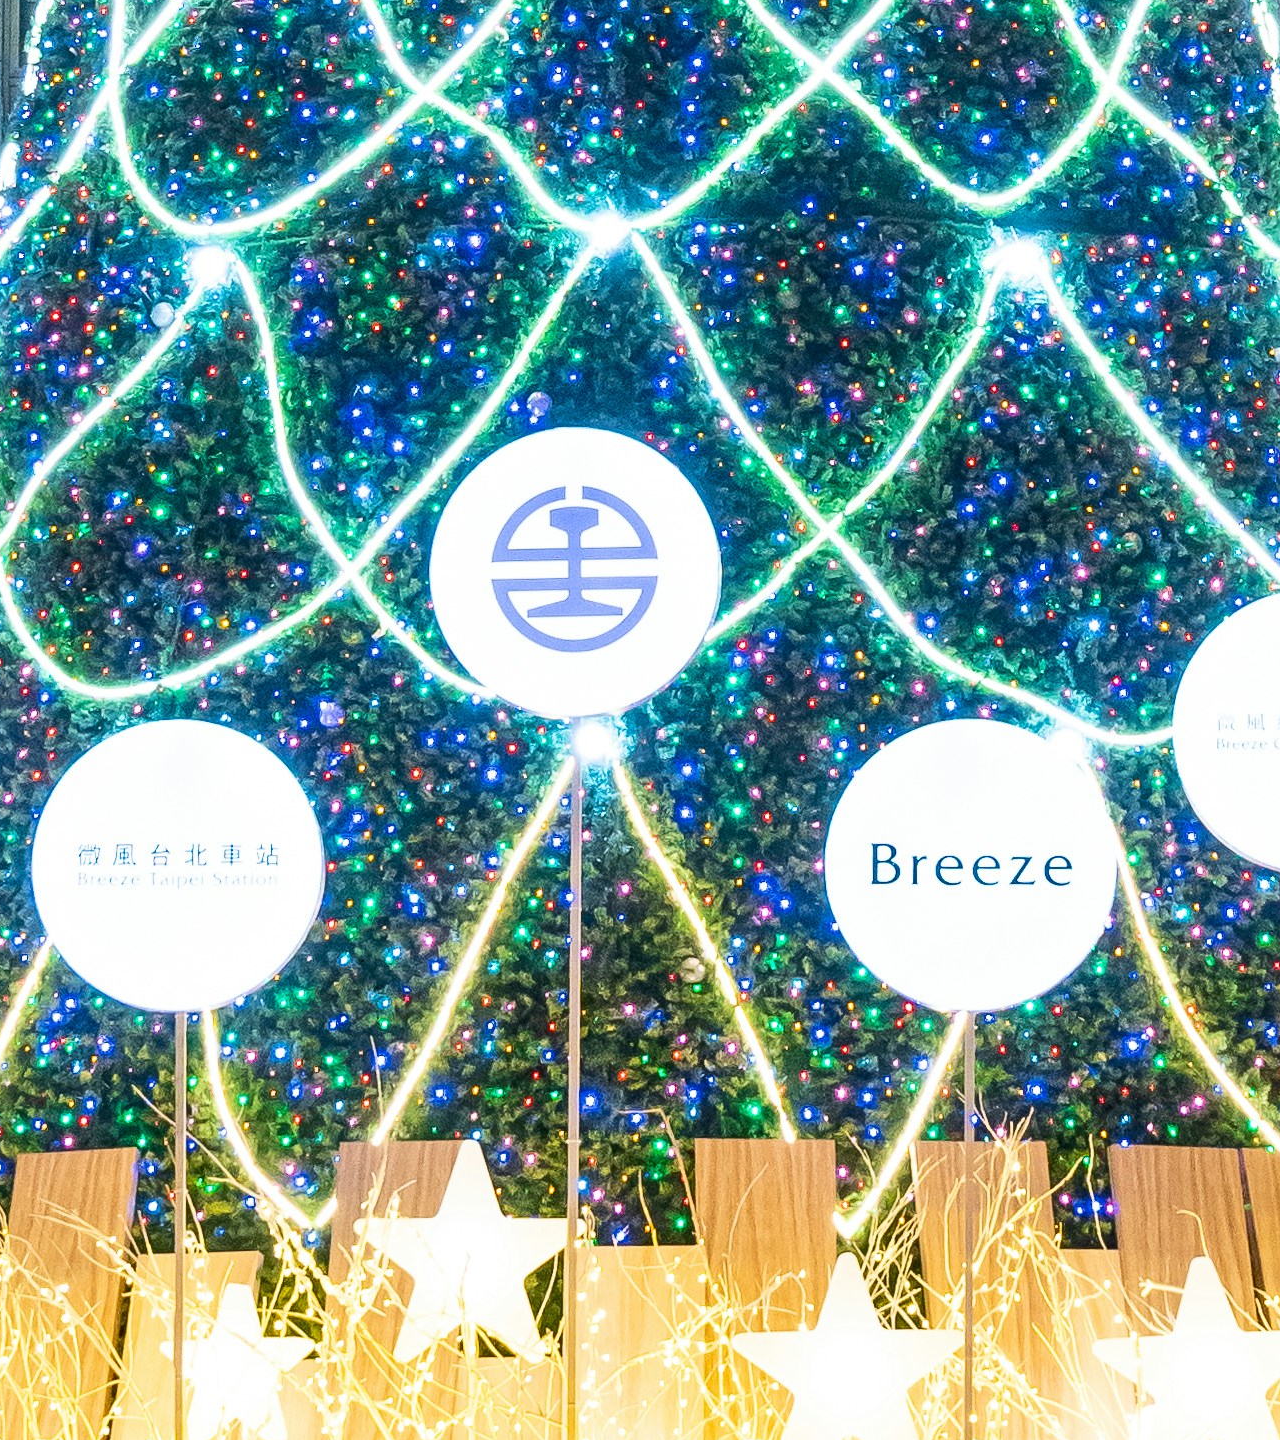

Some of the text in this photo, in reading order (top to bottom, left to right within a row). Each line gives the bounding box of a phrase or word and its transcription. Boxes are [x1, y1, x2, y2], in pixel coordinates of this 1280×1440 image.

[1216, 737, 1269, 750] Breeze
[76, 842, 280, 868] 微風台北車站
[870, 842, 1074, 887] Breeze
[77, 871, 279, 890] Breeze Taipei Station
